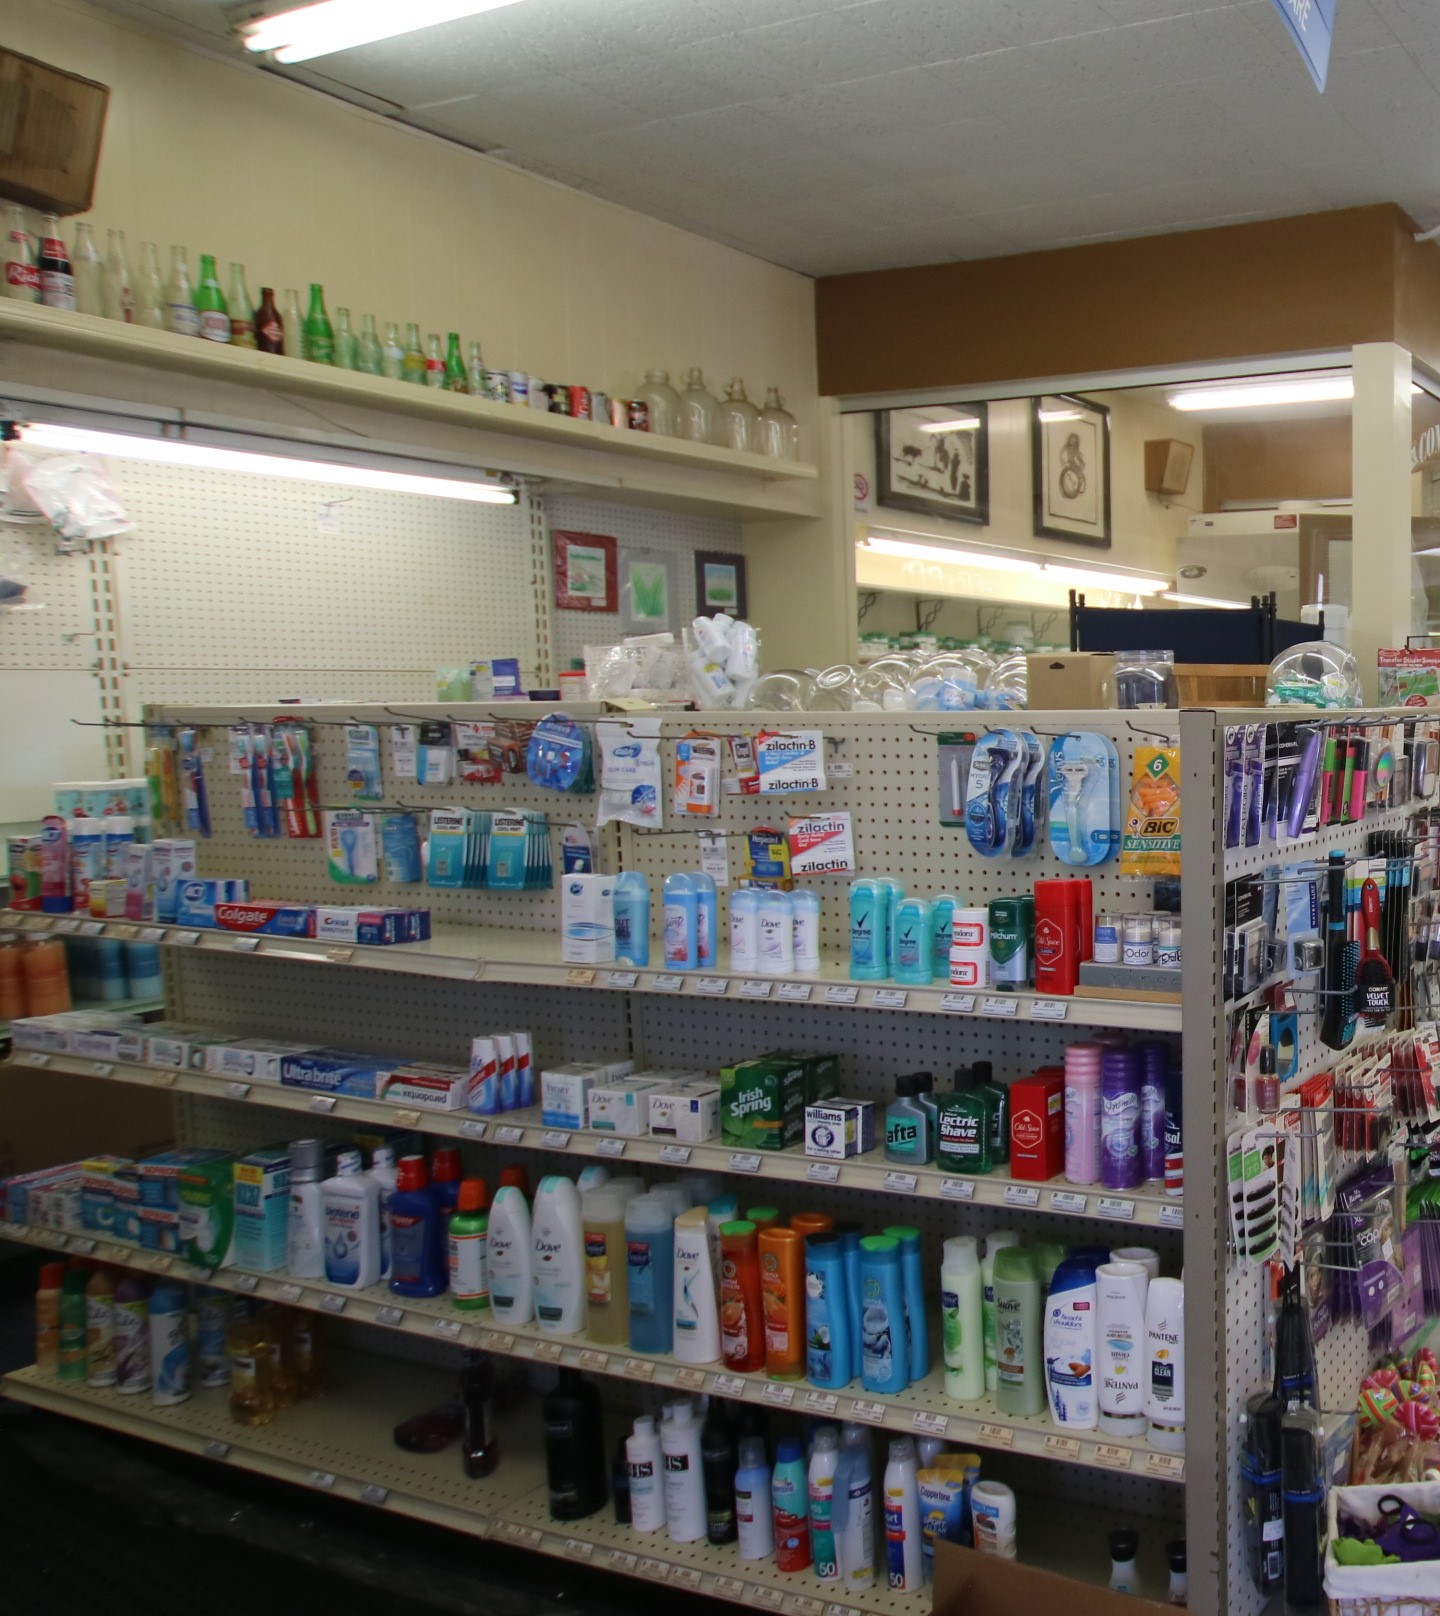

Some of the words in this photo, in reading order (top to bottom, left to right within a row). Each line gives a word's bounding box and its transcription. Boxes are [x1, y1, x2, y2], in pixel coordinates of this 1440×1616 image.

[1153, 757, 1163, 772] 6
[433, 816, 464, 826] LISTERINE
[494, 818, 525, 827] LISTERINE
[797, 821, 845, 834] zilactin
[1123, 839, 1181, 850] SENSITIVE
[800, 858, 848, 872] zilactin
[216, 906, 268, 924] Colgate
[760, 918, 781, 929] Dove
[851, 928, 872, 937] Degree
[989, 931, 1018, 941] Mitchum
[1366, 991, 1389, 1000] VELVET
[1366, 999, 1389, 1007] TOUCH
[546, 1083, 571, 1095] IVORY
[402, 1089, 448, 1105] parodontax
[591, 1094, 613, 1105] Dove
[738, 1087, 764, 1104] Irish
[652, 1098, 675, 1110] Dove
[730, 1096, 772, 1118] Spring
[806, 1108, 842, 1122] williams
[939, 1111, 979, 1127] Lectric
[887, 1122, 918, 1144] afta
[940, 1125, 978, 1138] Shave
[1014, 1122, 1026, 1131] Old
[1026, 1122, 1041, 1133] Spice
[1353, 1216, 1364, 1225] XL
[490, 1238, 512, 1249] Dove
[1360, 1229, 1380, 1247] cap
[537, 1240, 562, 1252] Dove
[676, 1248, 700, 1260] Dove
[997, 1298, 1021, 1312] Suave
[1148, 1330, 1179, 1342] PANTENE
[1153, 1367, 1172, 1377] CLEAN
[1104, 1380, 1139, 1390] PANTENE
[920, 1486, 951, 1501] Coppertone
[885, 1513, 898, 1524] ort
[818, 1562, 836, 1577] 50
[889, 1572, 904, 1587] 50
